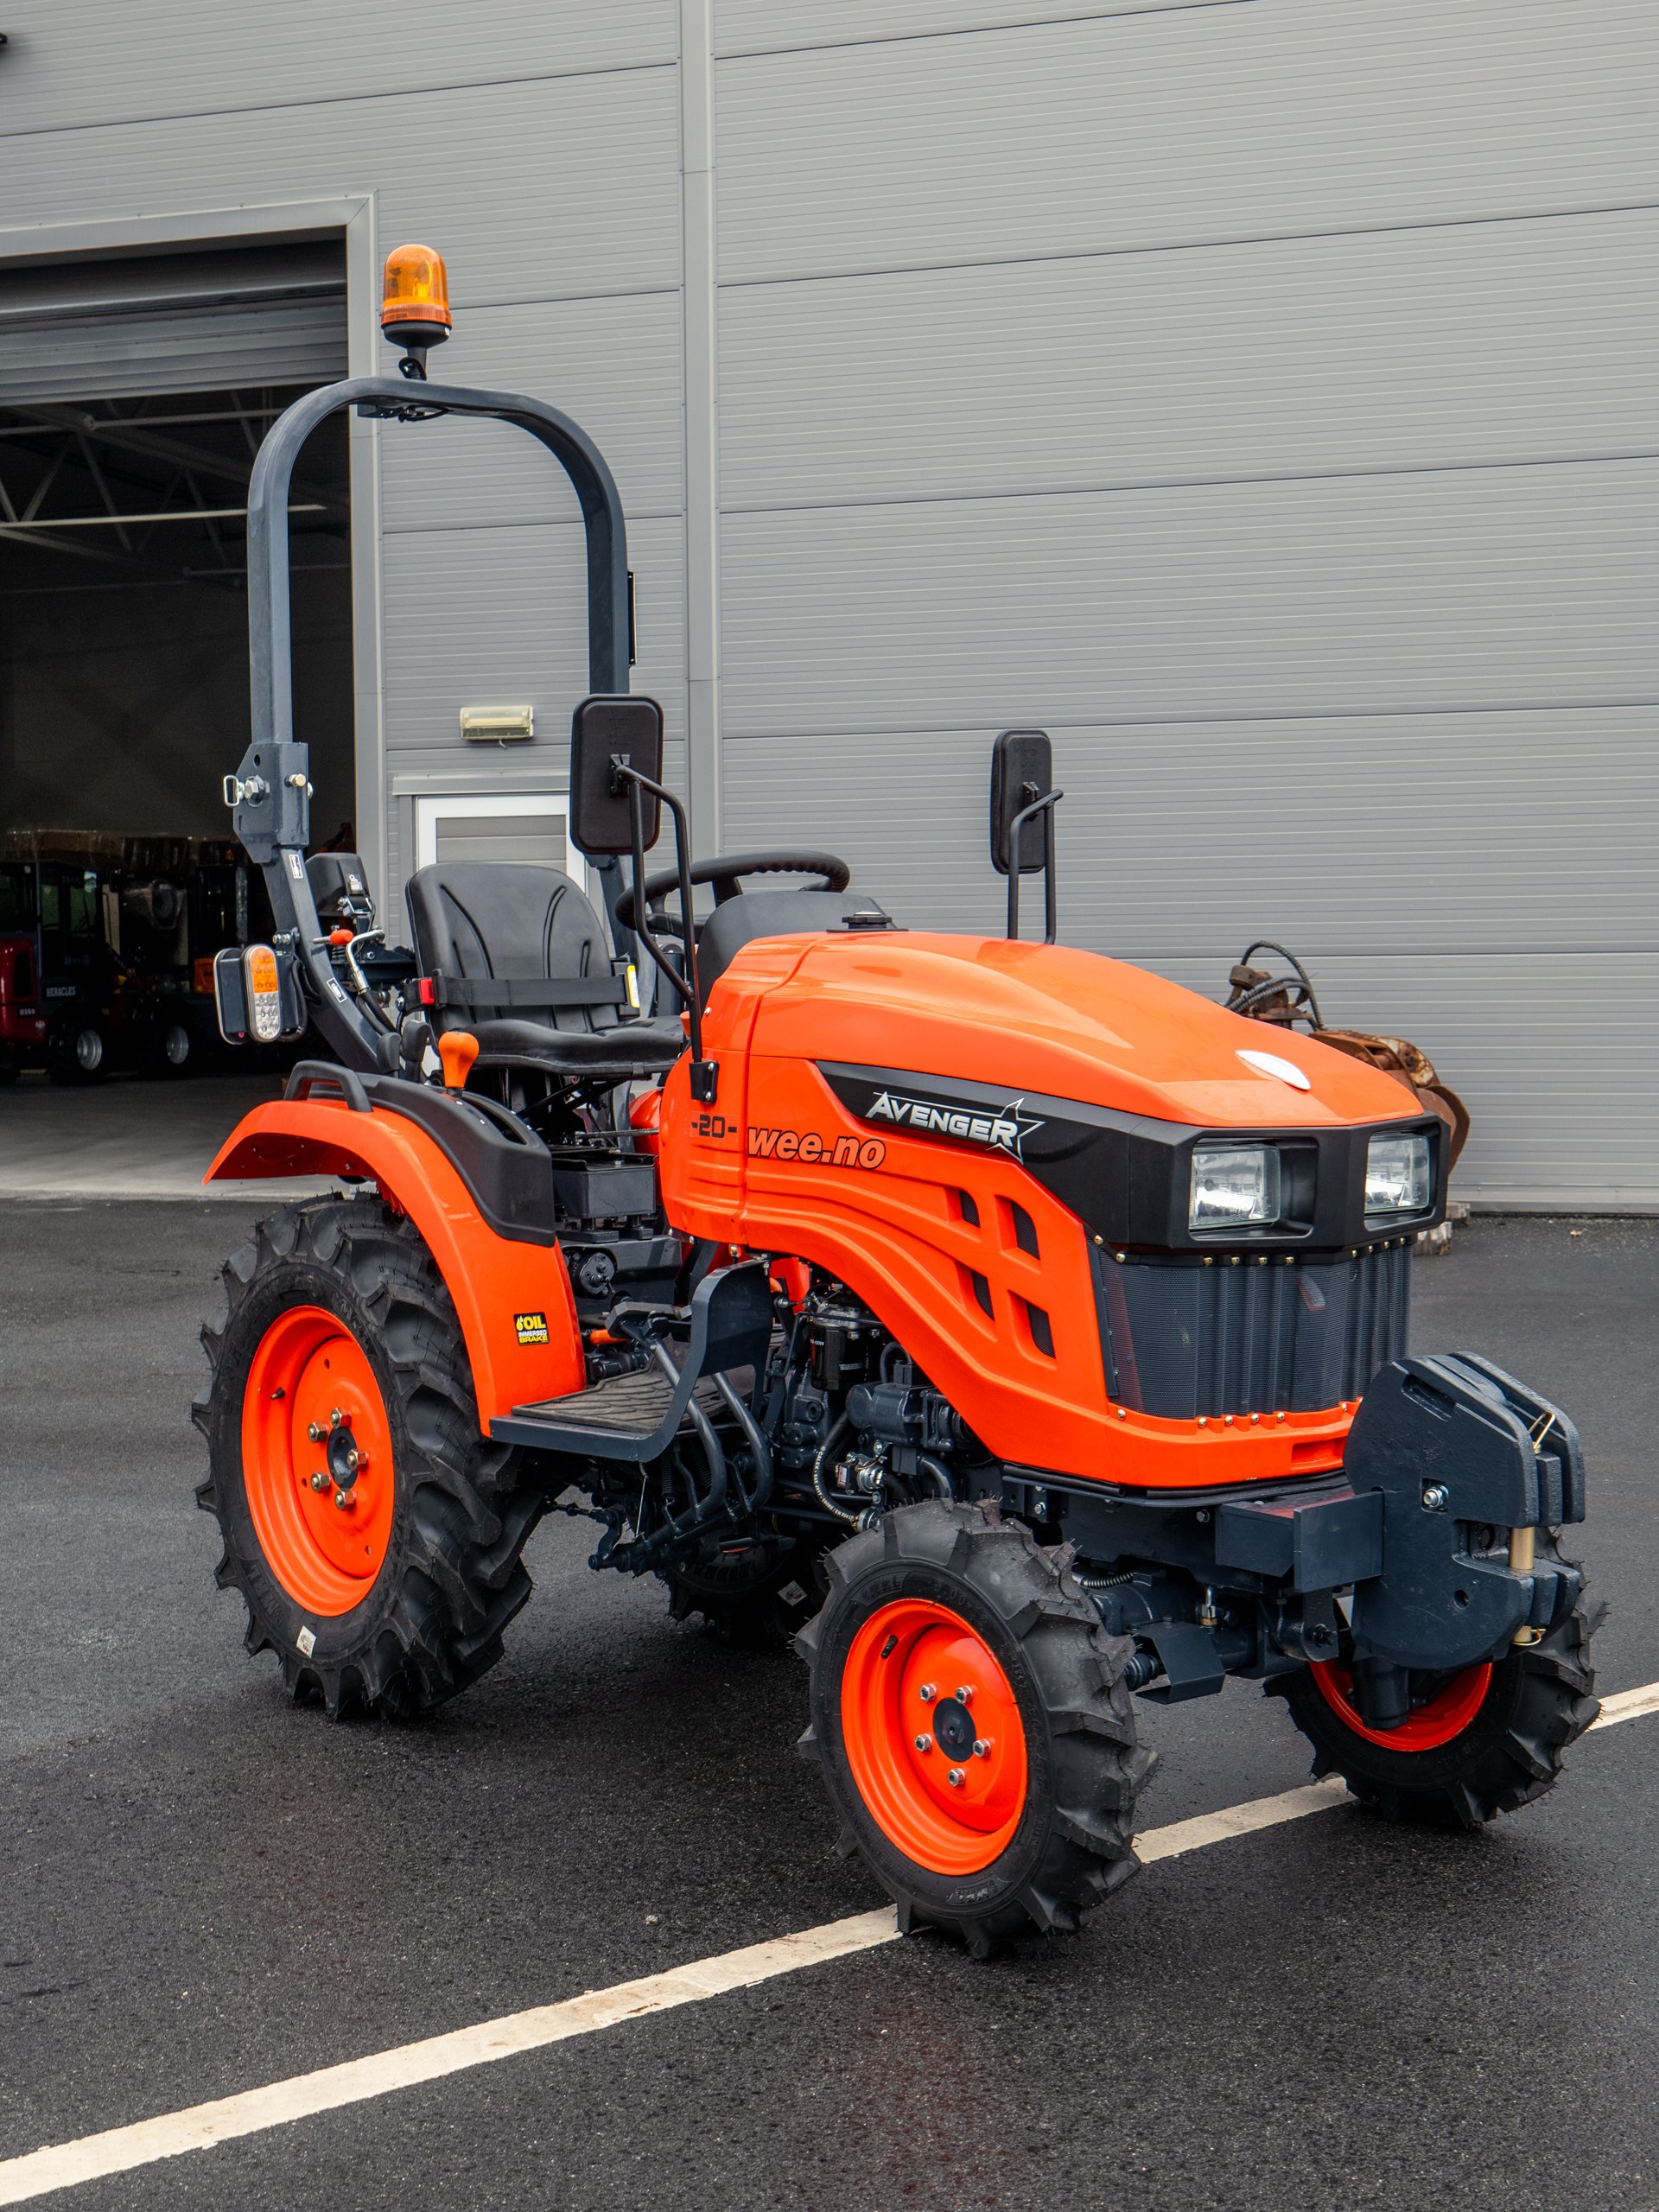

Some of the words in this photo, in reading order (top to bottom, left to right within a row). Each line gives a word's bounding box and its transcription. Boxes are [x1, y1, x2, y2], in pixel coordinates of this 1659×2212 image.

[46, 986, 76, 997] HERACLES
[865, 1091, 1019, 1147] AVENGER
[747, 1125, 887, 1171] wee.no
[524, 1315, 545, 1330] OIL
